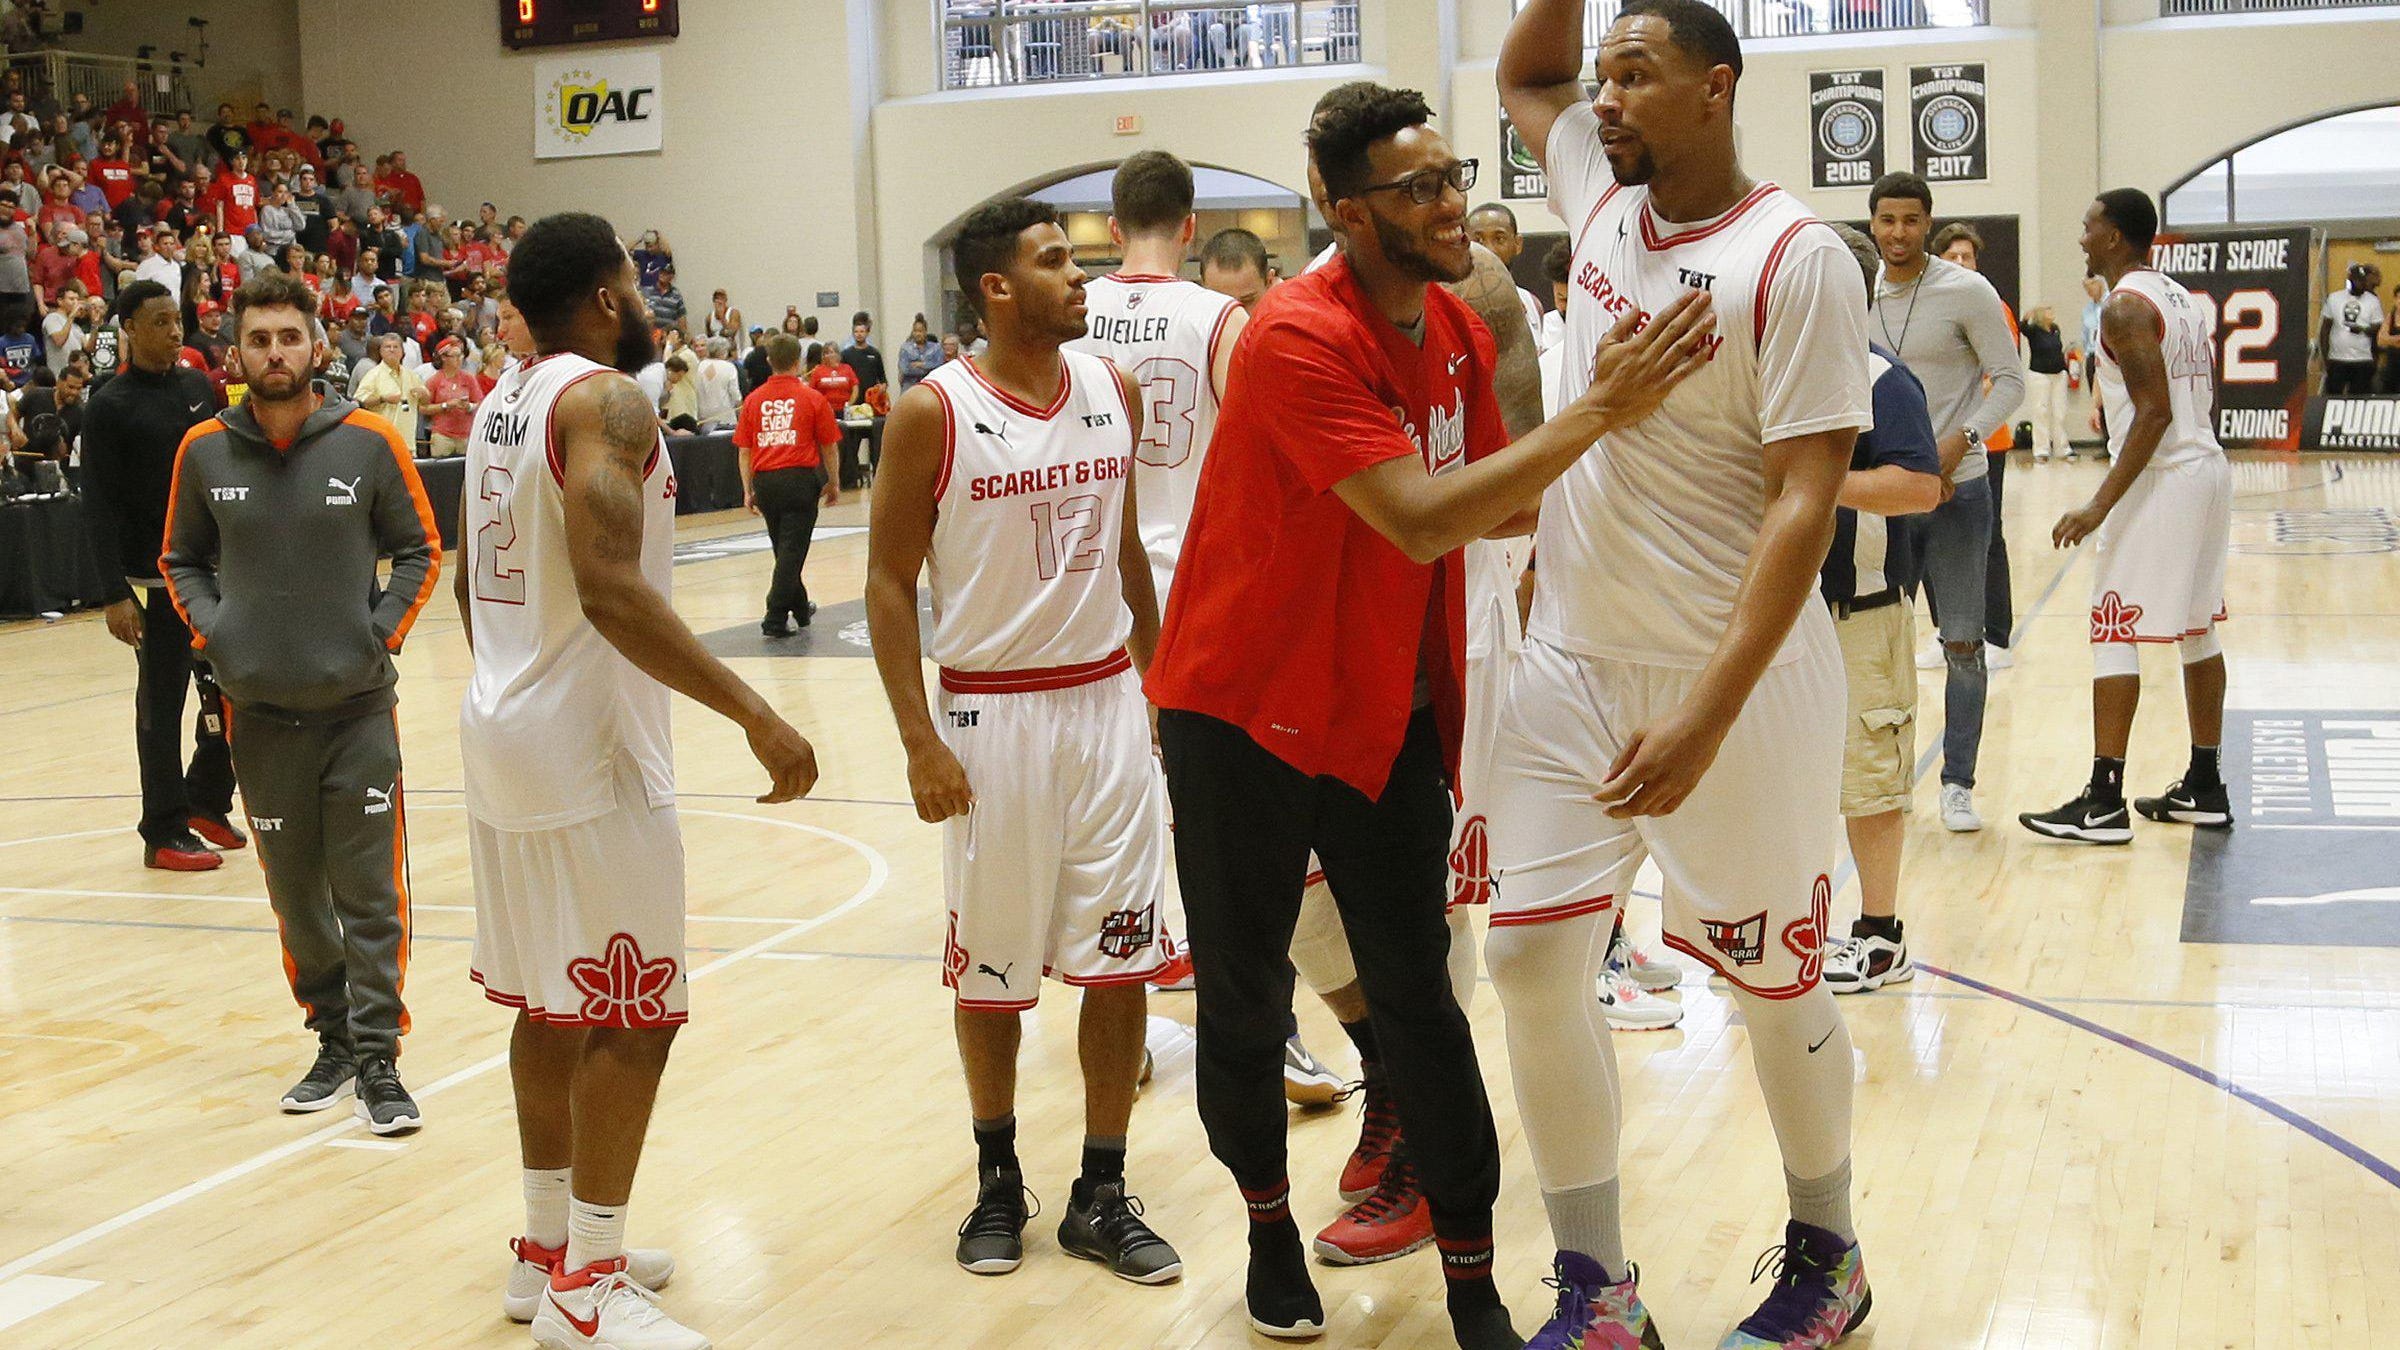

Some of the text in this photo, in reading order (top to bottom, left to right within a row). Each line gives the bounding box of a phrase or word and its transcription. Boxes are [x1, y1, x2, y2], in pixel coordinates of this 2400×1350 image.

[1831, 73, 1862, 85] TBT
[1931, 66, 1963, 79] TBT
[1812, 86, 1883, 106] CHAMPIONS
[1911, 79, 1984, 100] CHAMPIONS
[567, 88, 653, 125] OAC
[1826, 161, 1872, 183] 2016
[1926, 155, 1973, 177] 2017
[1513, 174, 1546, 195] 201
[2151, 239, 2290, 273] TARGET SCORE
[1678, 267, 1716, 291] TBT
[761, 399, 796, 415] CSC
[761, 415, 793, 431] EVENT
[1081, 412, 1113, 429] TBT
[2219, 409, 2289, 440] ENDING
[2320, 434, 2400, 448] BASKETBAL
[970, 464, 1070, 502] SCARLET
[1075, 461, 1090, 485] &
[211, 487, 249, 501] TBT
[326, 495, 353, 505] PUMA
[475, 466, 526, 605] 2
[1031, 494, 1104, 581] 12
[949, 710, 980, 728] TBT
[2251, 720, 2312, 816] BASKETBALL
[252, 816, 283, 831] TBT
[1731, 950, 1759, 958] GRAY
